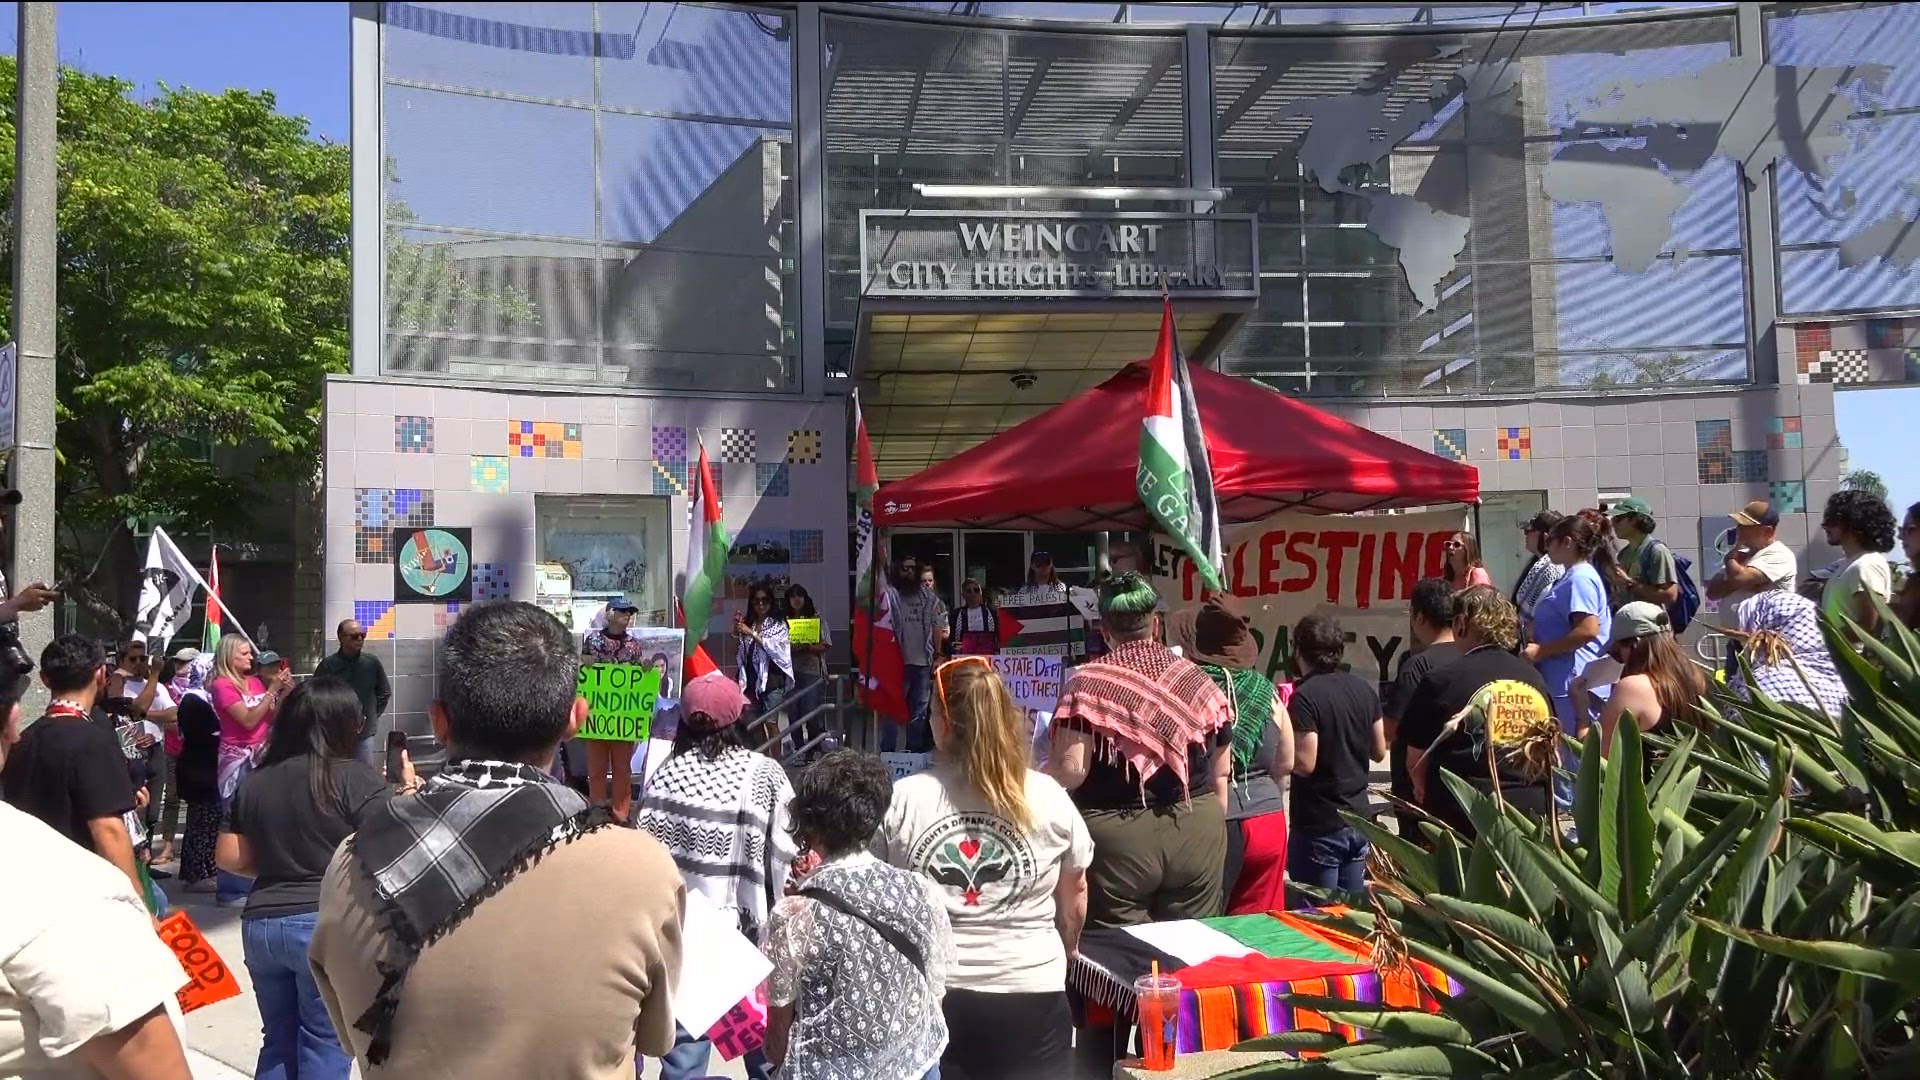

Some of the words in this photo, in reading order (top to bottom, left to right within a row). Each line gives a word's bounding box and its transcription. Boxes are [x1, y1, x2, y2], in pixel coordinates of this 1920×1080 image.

[959, 222, 1164, 253] WEINGART
[890, 260, 957, 286] CITY
[974, 262, 1099, 287] HEIGHTS
[1115, 263, 1230, 288] LIBRARY
[1181, 529, 1458, 610] PLESTIN
[1032, 643, 1081, 655] PALESTNE
[578, 664, 643, 689] STOP
[1004, 656, 1033, 677] STATE
[577, 689, 654, 713] UNDING
[159, 916, 225, 984] FOOD
